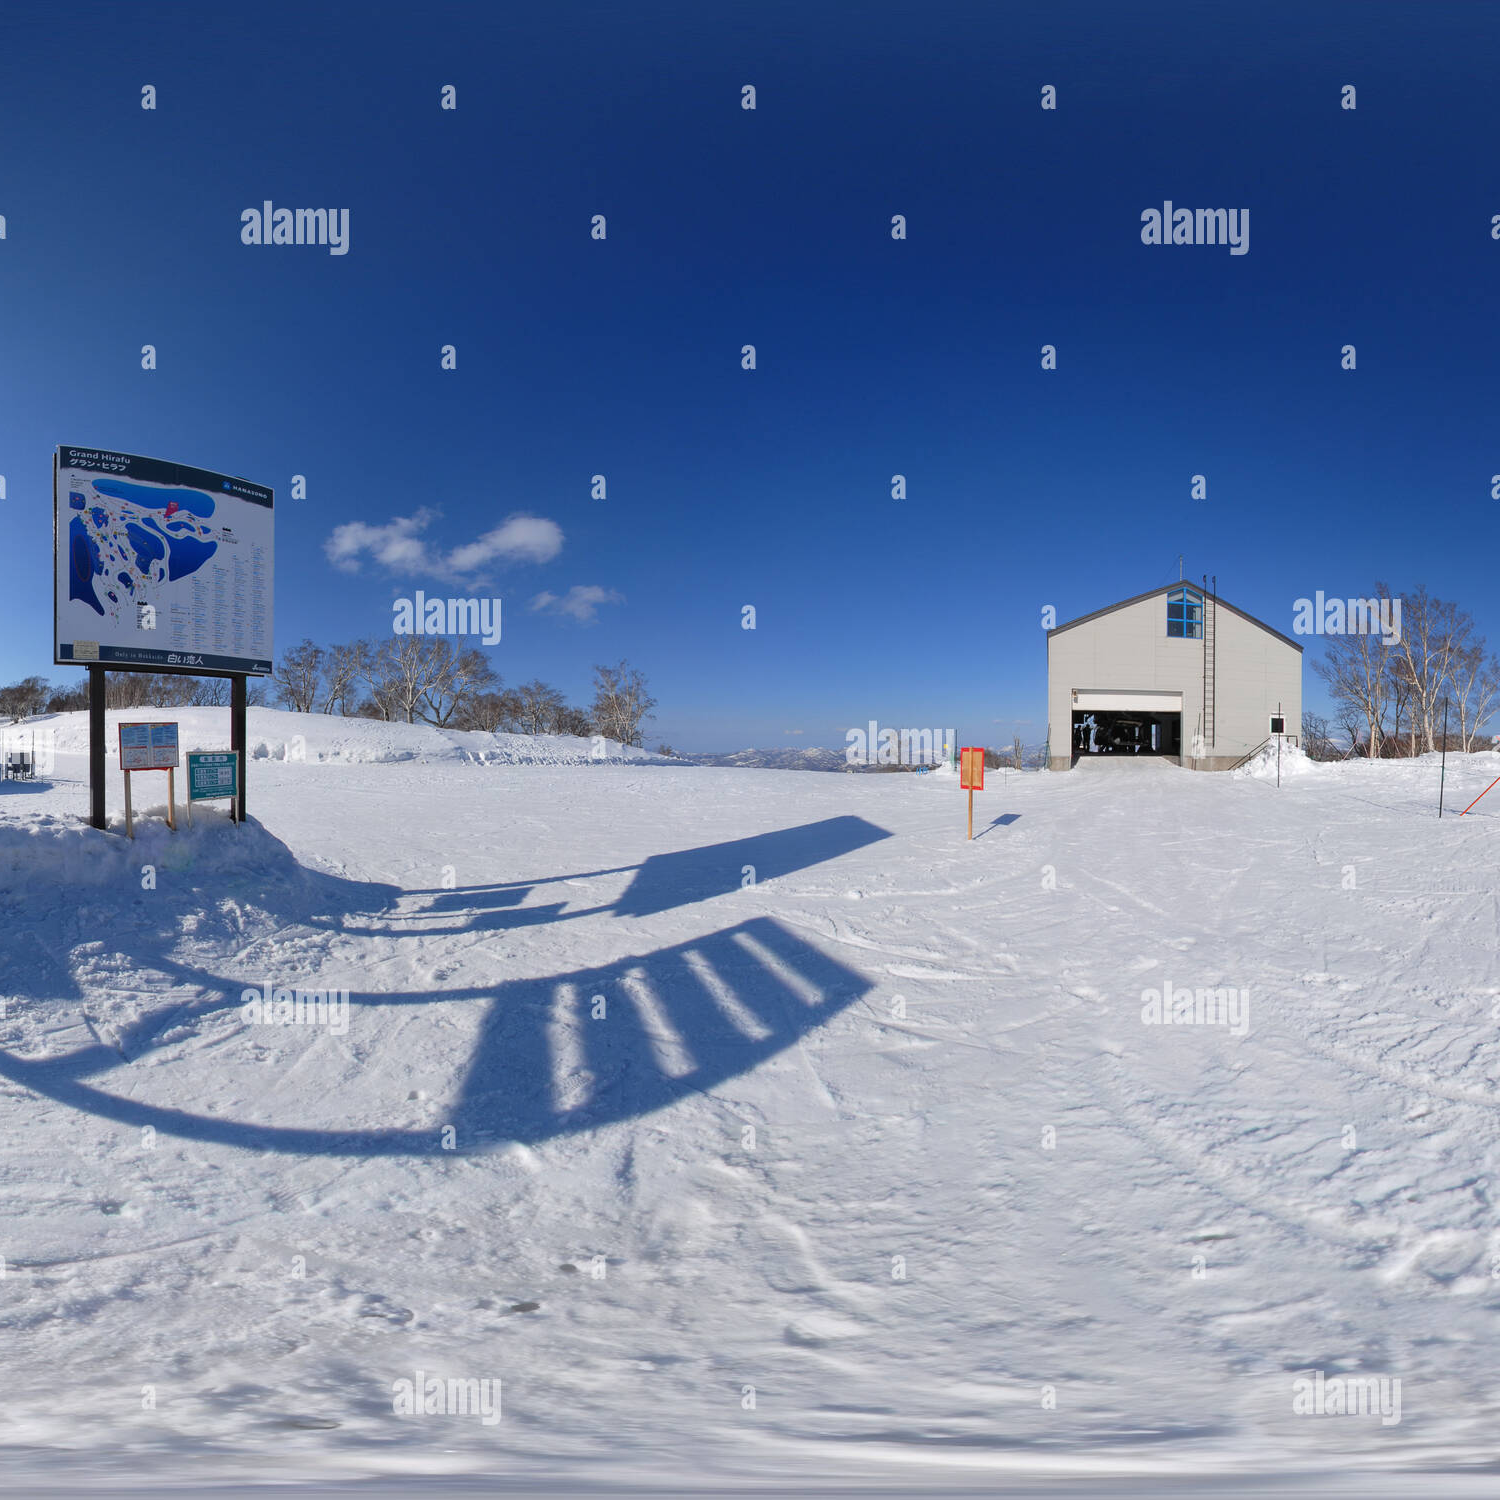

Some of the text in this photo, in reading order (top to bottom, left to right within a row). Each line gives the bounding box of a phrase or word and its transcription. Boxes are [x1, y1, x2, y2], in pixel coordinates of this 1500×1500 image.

[69, 450, 131, 464] Grand Hirafu
[69, 458, 127, 472] グラン・ヒラフ
[232, 485, 268, 499] HANAZONO
